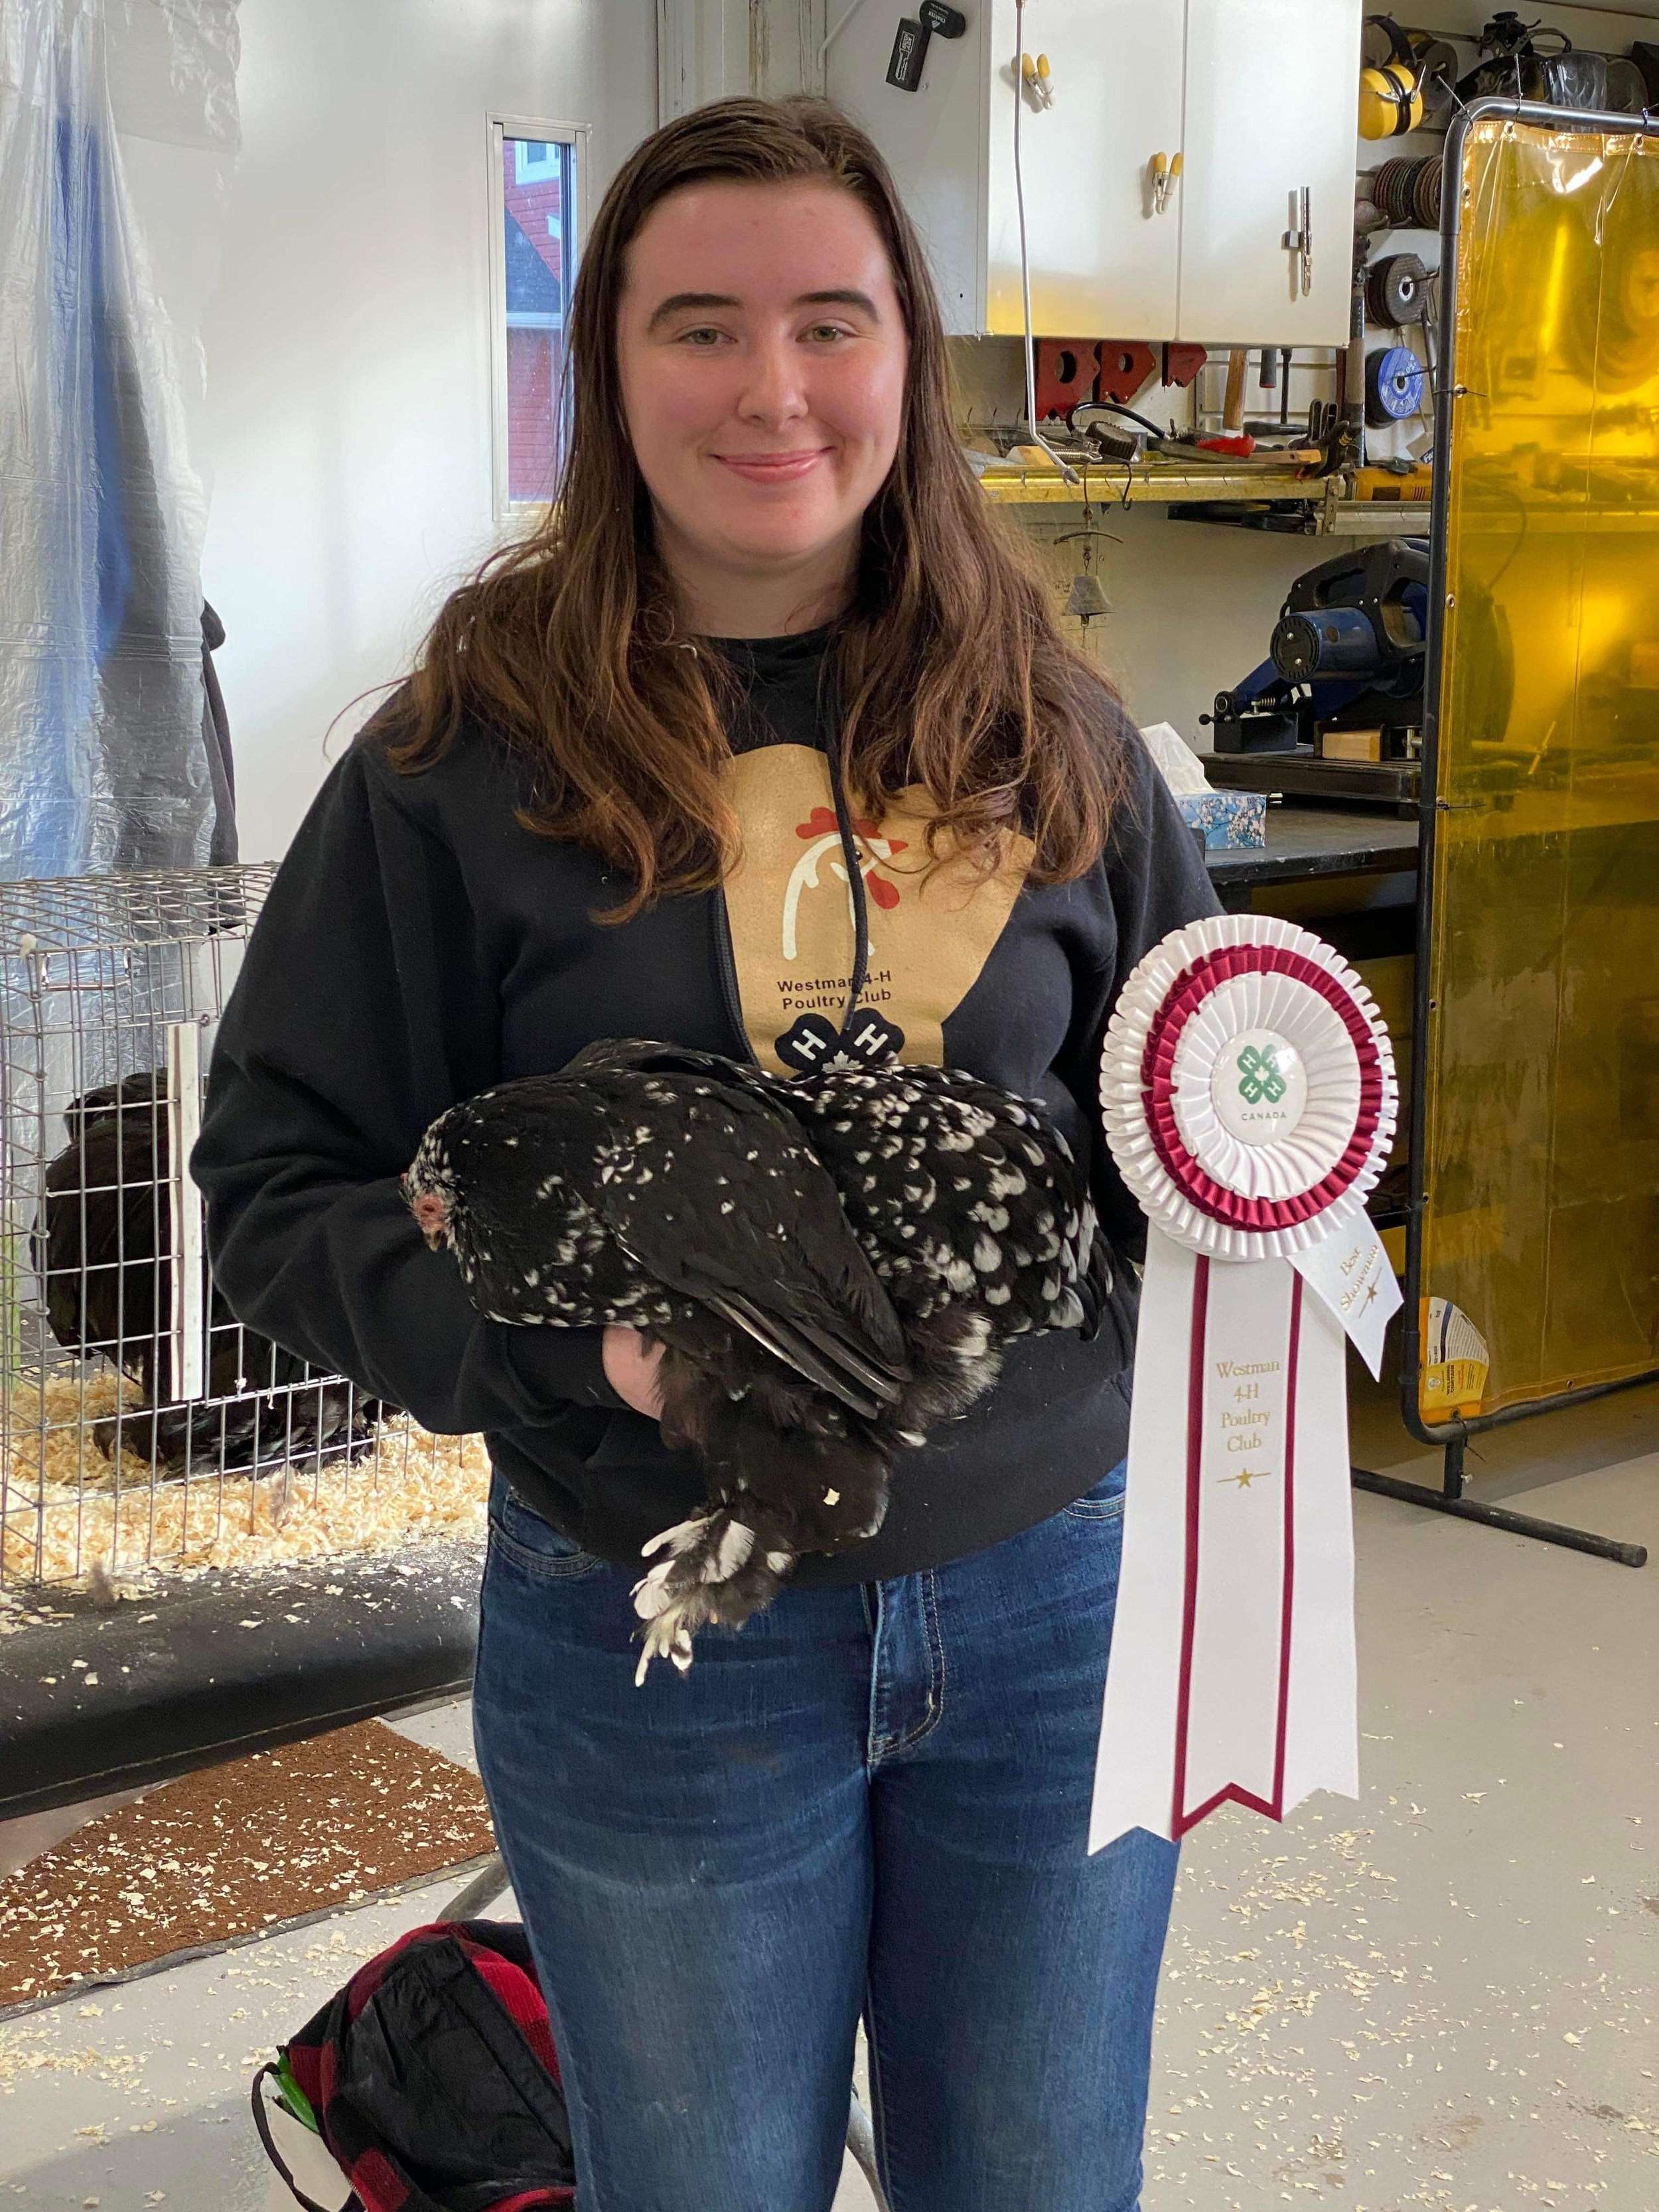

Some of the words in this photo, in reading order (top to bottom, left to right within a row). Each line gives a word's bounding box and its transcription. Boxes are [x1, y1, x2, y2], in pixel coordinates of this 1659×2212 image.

[782, 995, 845, 1009] Poultry
[792, 1029, 826, 1061] H
[854, 1023, 888, 1055] H
[1242, 1112, 1287, 1121] CANADA
[1340, 1246, 1359, 1276] Best
[1216, 1361, 1280, 1378] Westman
[1221, 1408, 1271, 1428] Poultry
[1228, 1432, 1262, 1451] Club
